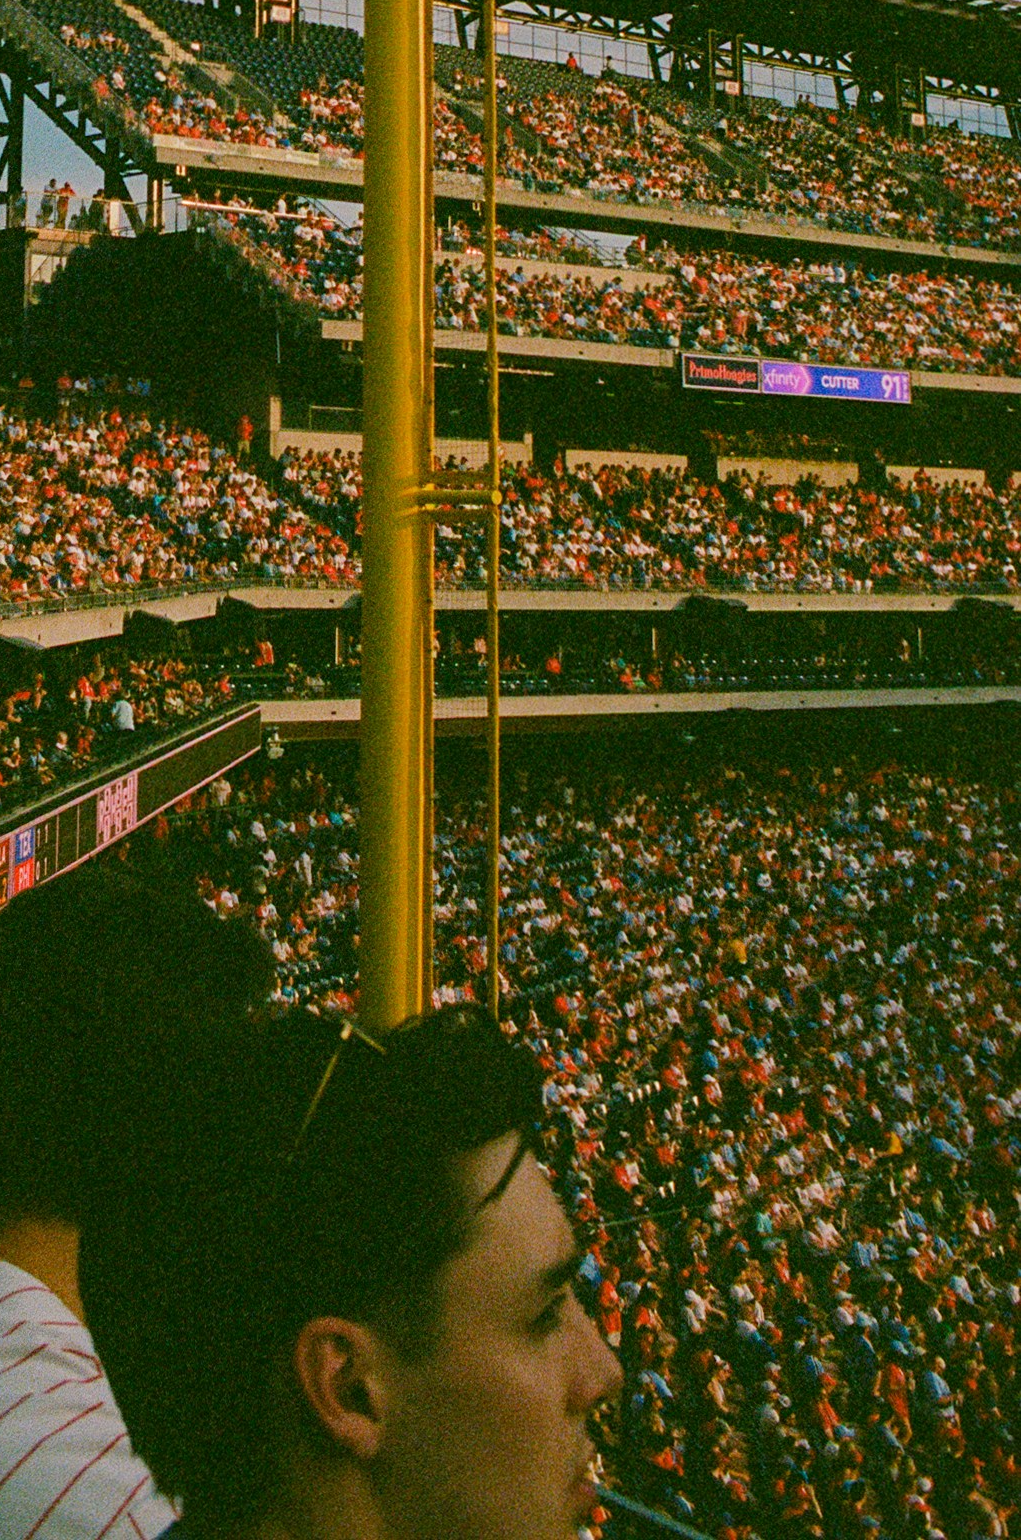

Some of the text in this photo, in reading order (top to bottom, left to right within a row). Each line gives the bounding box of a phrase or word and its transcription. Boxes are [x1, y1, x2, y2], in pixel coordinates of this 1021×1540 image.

[764, 368, 801, 390] xfinity
[821, 374, 859, 391] CUTTER
[881, 373, 901, 399] 91
